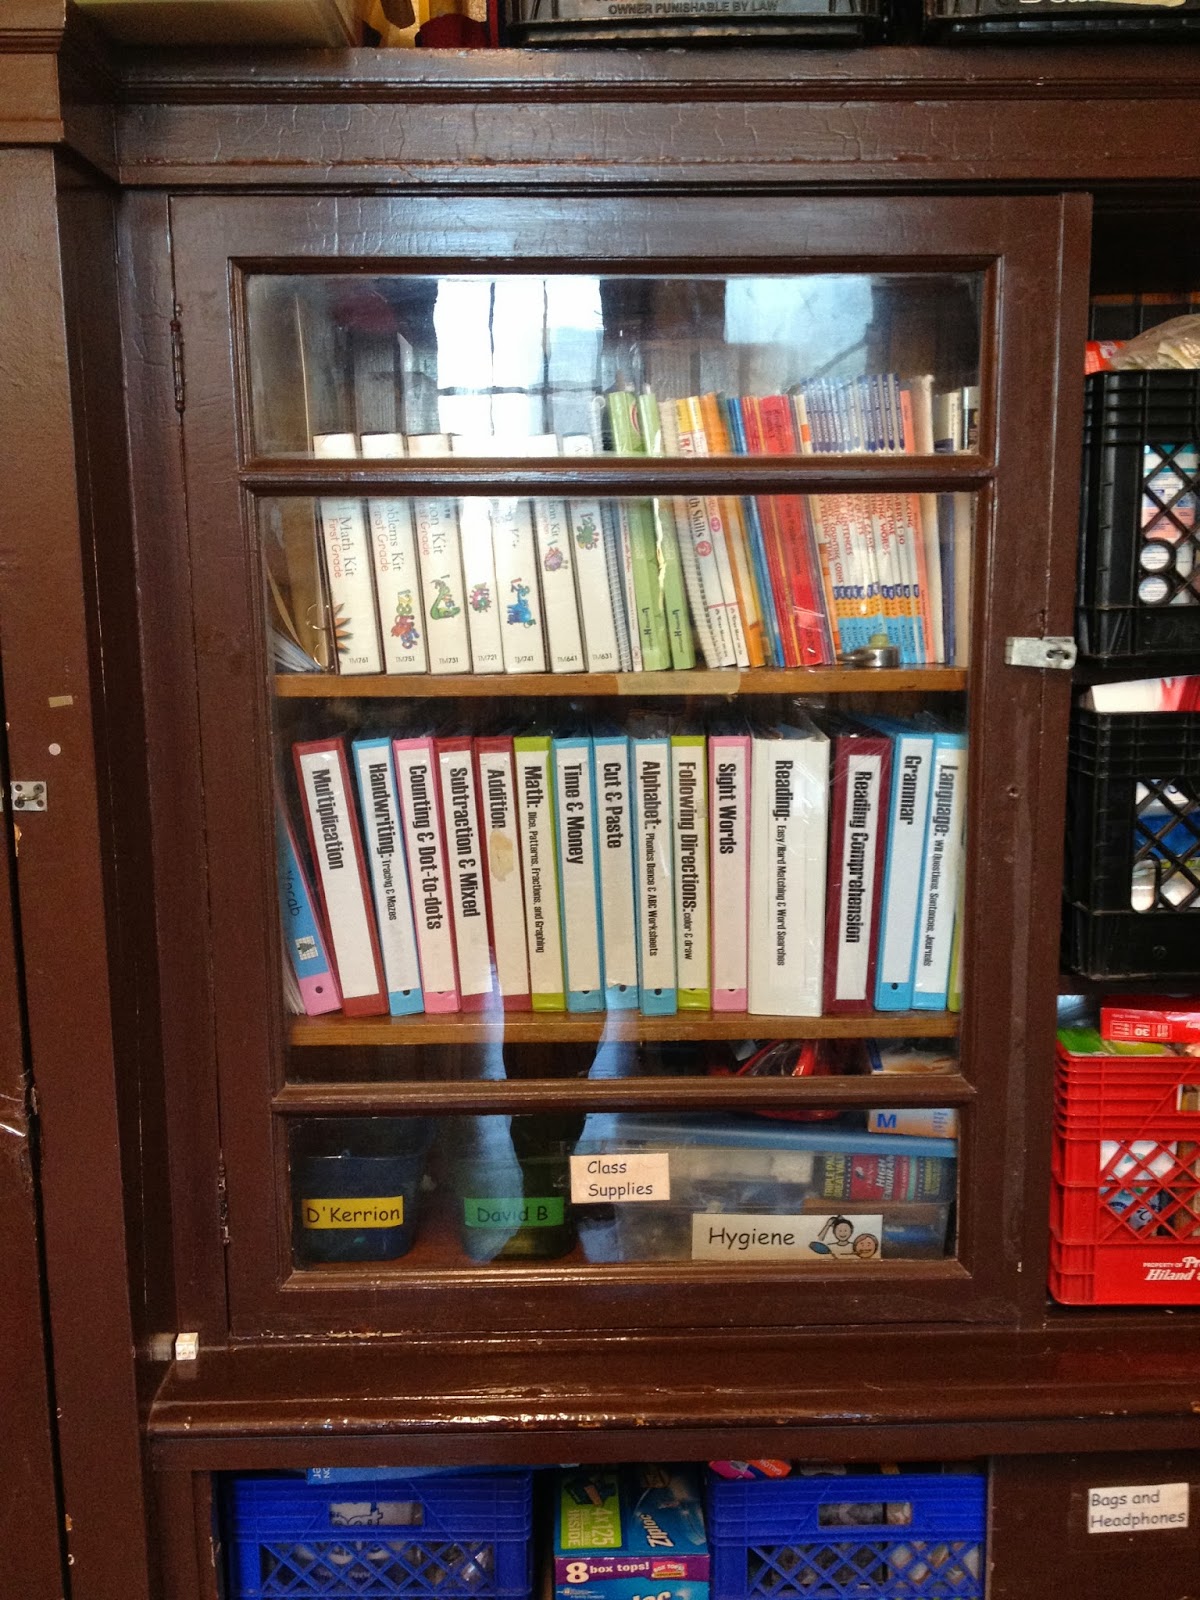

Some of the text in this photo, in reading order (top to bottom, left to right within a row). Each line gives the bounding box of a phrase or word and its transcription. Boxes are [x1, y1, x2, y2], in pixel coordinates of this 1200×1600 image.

[608, 1, 777, 14] OWNER PUNISHABLE BY LAW
[386, 499, 403, 571] oblems Kit
[420, 522, 430, 556] Grade
[691, 509, 705, 538] Skills
[880, 523, 890, 555] WORDS
[328, 518, 343, 578] First Grade
[339, 516, 356, 576] Math Kit
[378, 534, 389, 572] Grade
[432, 533, 445, 554] Kit
[830, 522, 840, 560] COUNTING
[835, 562, 844, 583] COINS
[564, 763, 583, 800] Time
[603, 762, 622, 789] Cut
[773, 760, 794, 822] Reading:
[900, 755, 923, 826] Grammar
[369, 763, 396, 860] Handwriting:
[409, 765, 433, 830] Counting
[450, 767, 473, 856] Subtraction
[487, 769, 507, 829] Addition
[642, 761, 662, 831] Alphabet:
[678, 761, 697, 830] Following
[718, 763, 738, 855] Sight Words
[932, 765, 958, 836] Language:
[311, 768, 344, 870] Multiplication
[605, 804, 623, 849] Paste
[566, 816, 585, 865] Money
[645, 833, 656, 861] Phonics
[776, 825, 787, 862] Easy/Hard
[845, 771, 873, 944] Reading Comprehension
[382, 860, 394, 887] Tracing
[524, 766, 545, 953] Math: Dice, Patterns, Fractions, and Graphing
[646, 863, 656, 884] Dance
[679, 833, 698, 913] Directions:
[929, 854, 943, 891] Questions,
[419, 845, 442, 931] Dot-to-dots
[460, 873, 481, 918] Mixed
[776, 864, 787, 893] Matching
[385, 895, 397, 921] Mazes
[647, 893, 656, 909] ABC
[776, 903, 785, 926] Word
[926, 893, 939, 933] Sentences,
[647, 910, 658, 957] Worksheets
[683, 913, 692, 932] color
[684, 939, 693, 960] draw
[776, 928, 785, 966] Searches
[923, 934, 935, 967] Journals
[877, 1114, 897, 1128] M
[587, 1161, 627, 1174] Class
[876, 1159, 886, 1187] HIGH
[884, 1155, 894, 1200] ENDURAN
[588, 1183, 653, 1199] Supplies
[306, 1206, 400, 1224] D'Kerrion
[477, 1206, 548, 1223] David B
[709, 1228, 795, 1249] Hygiene
[1144, 1269, 1196, 1280] Hiland
[1091, 1489, 1160, 1509] Bags and
[568, 1510, 580, 1547] INSIDE
[640, 1513, 674, 1547] Ziploc
[1091, 1512, 1185, 1528] Headphones
[566, 1562, 650, 1584] 8 box tops!
